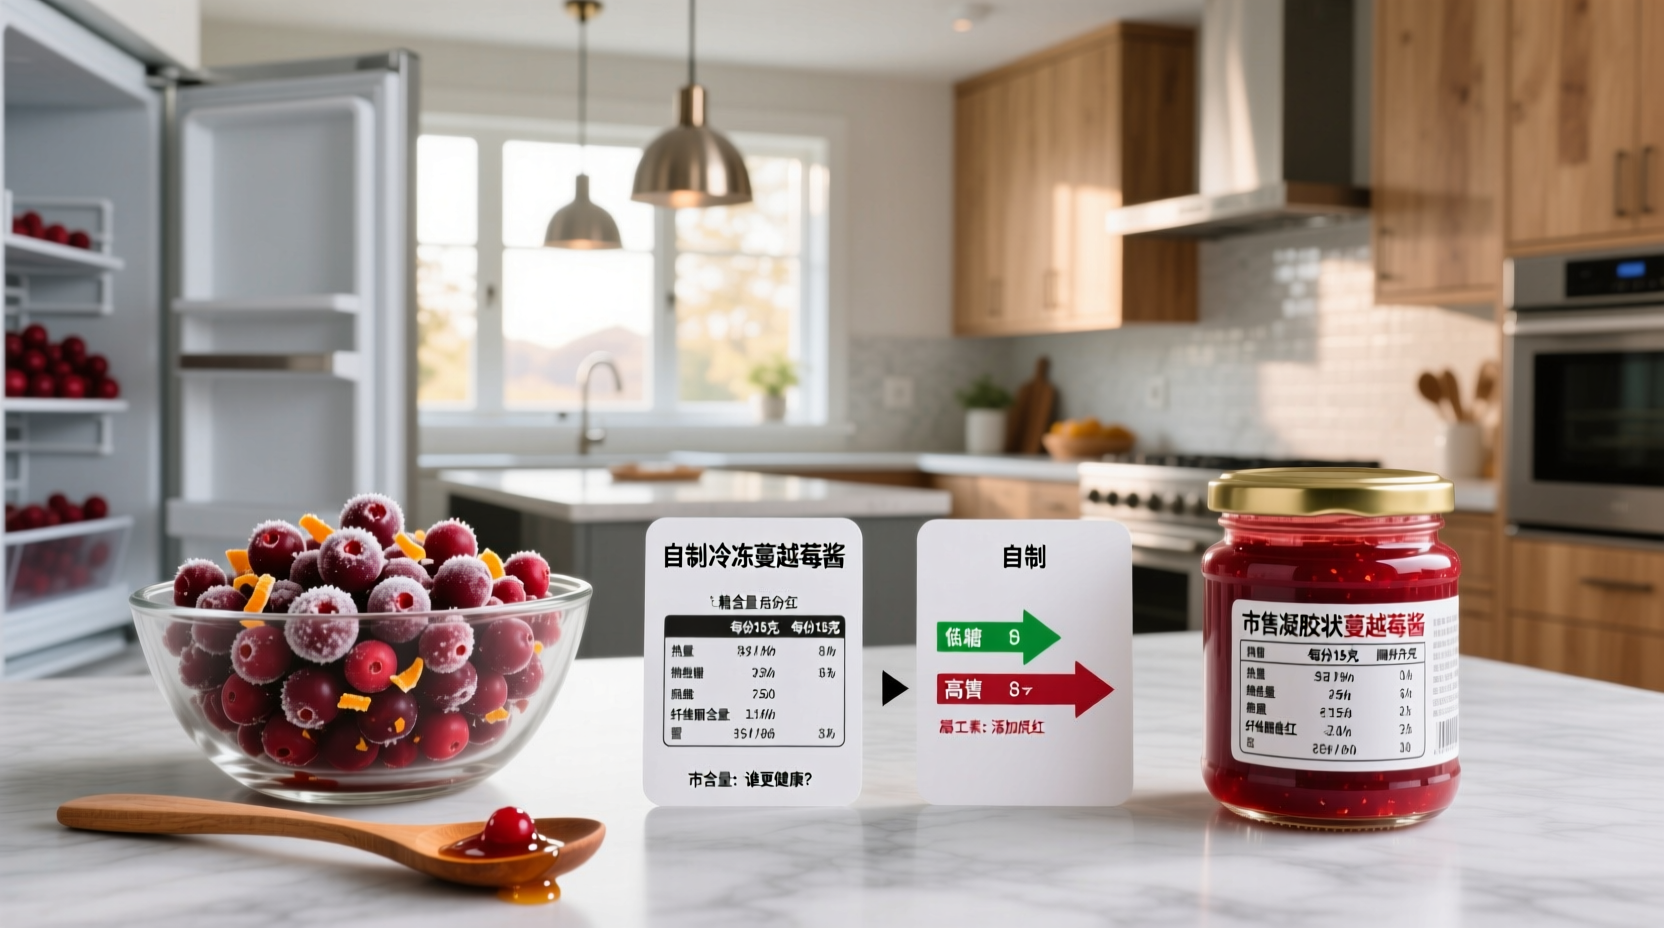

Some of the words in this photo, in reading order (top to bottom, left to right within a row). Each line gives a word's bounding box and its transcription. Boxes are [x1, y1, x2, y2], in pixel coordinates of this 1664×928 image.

[664, 542, 846, 569] 自制冷冻蔓越莓酱
[1003, 544, 1046, 569] 自制
[1242, 610, 1425, 638] 市售凝胶状蔓越莓酱
